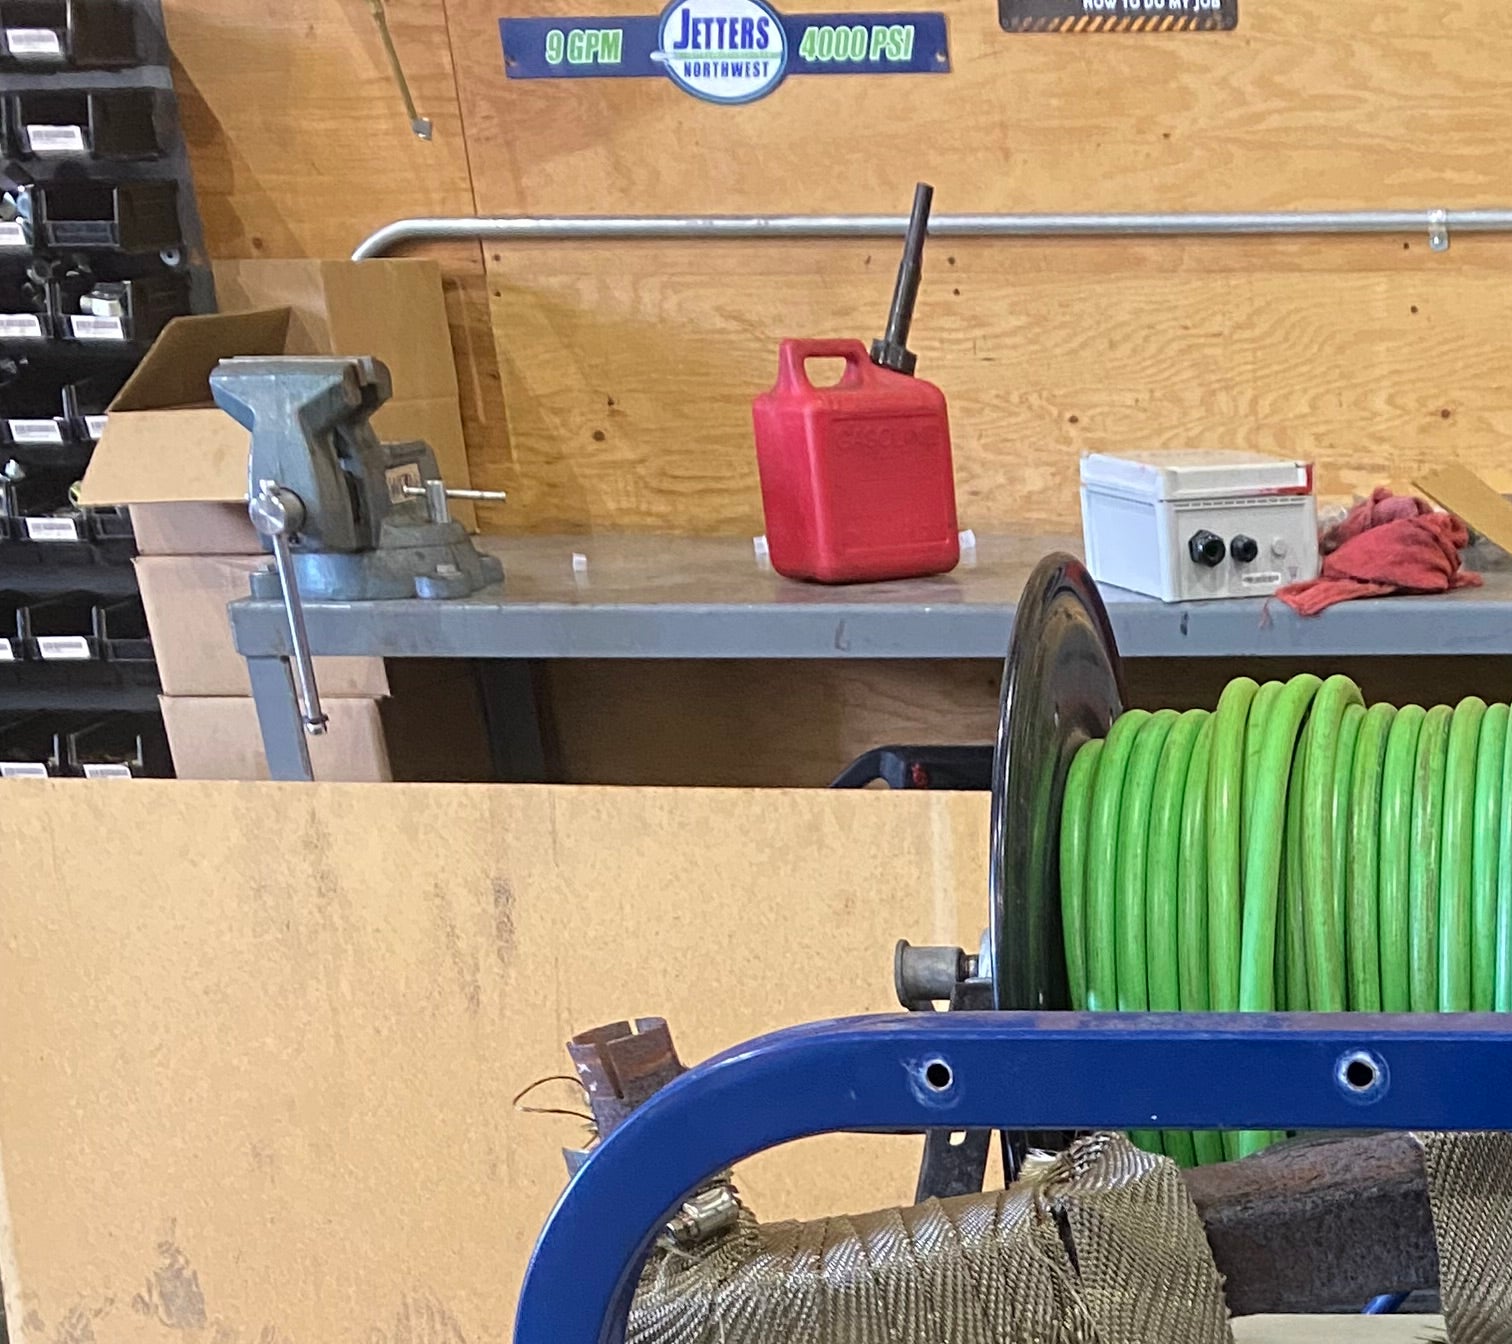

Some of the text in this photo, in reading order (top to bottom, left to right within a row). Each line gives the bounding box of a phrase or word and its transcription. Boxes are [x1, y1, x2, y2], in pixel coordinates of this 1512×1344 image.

[545, 28, 623, 64] 9 GPM
[673, 8, 769, 50] JETTERS
[800, 24, 915, 62] 4000 PSI
[683, 61, 769, 78] NORTHWEST
